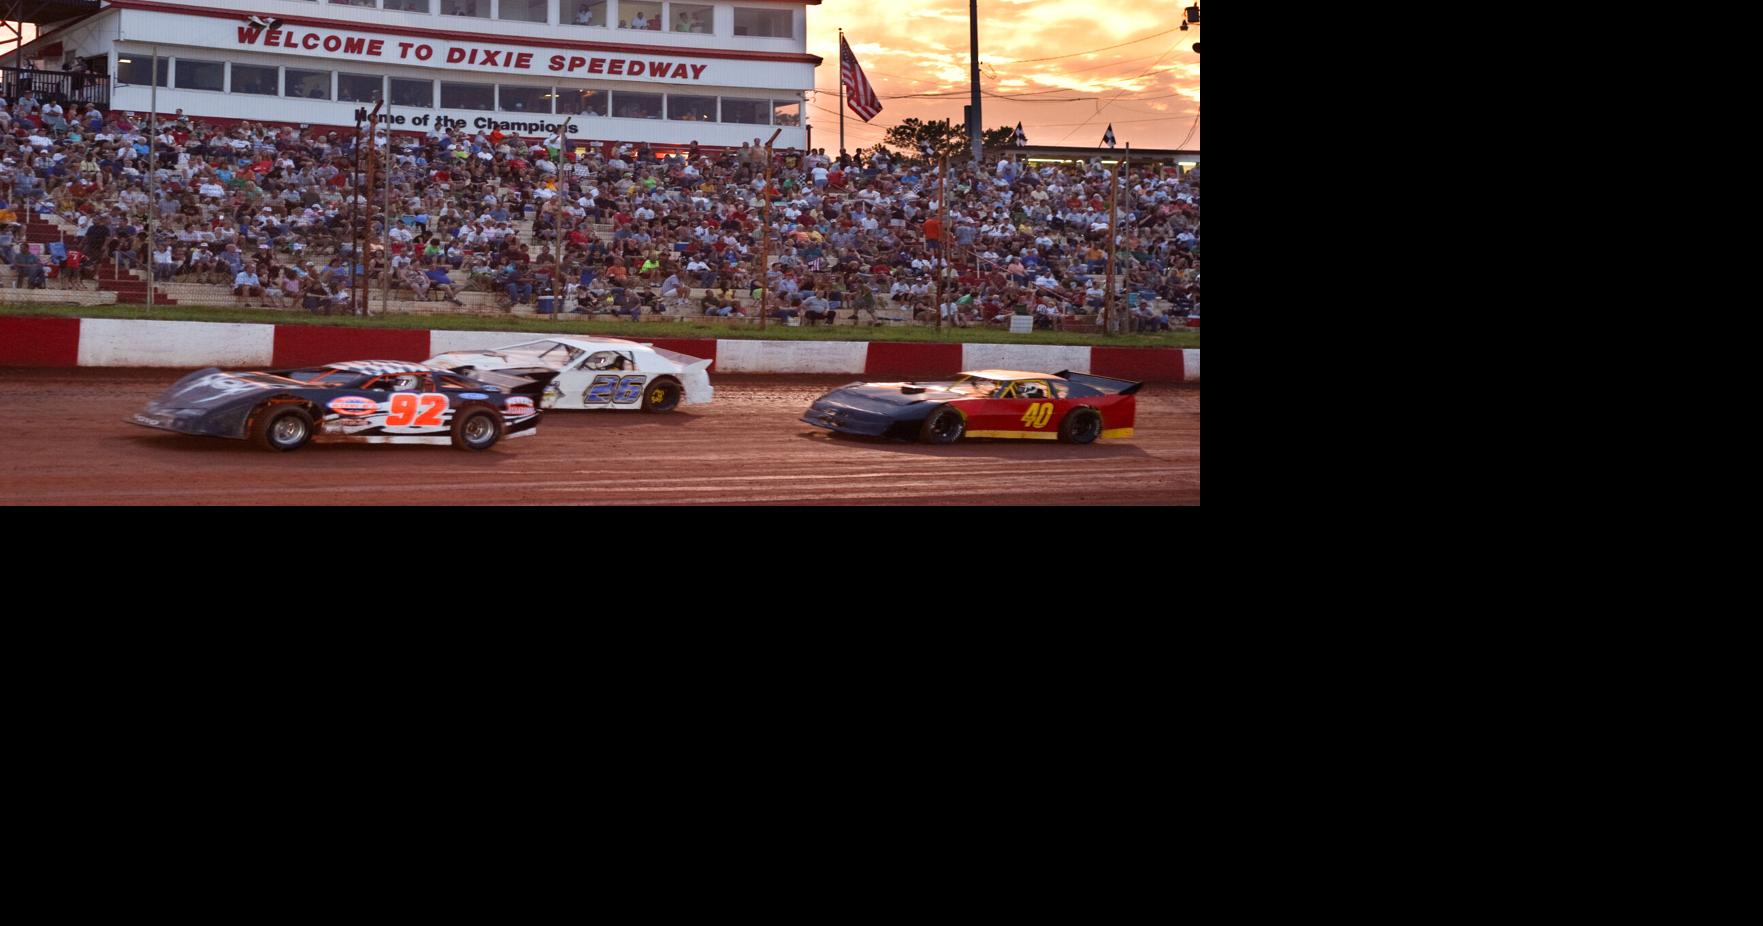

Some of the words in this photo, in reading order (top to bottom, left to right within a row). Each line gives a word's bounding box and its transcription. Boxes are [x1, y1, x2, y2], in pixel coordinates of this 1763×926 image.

[237, 27, 384, 56] WELCOME
[398, 43, 432, 61] TO
[446, 47, 533, 69] DIXIE
[548, 55, 708, 80] SPEEDWAY
[411, 114, 430, 127] of
[435, 115, 467, 129] the
[582, 375, 647, 405] 26
[384, 393, 450, 427] 92
[1021, 402, 1054, 429] 40
